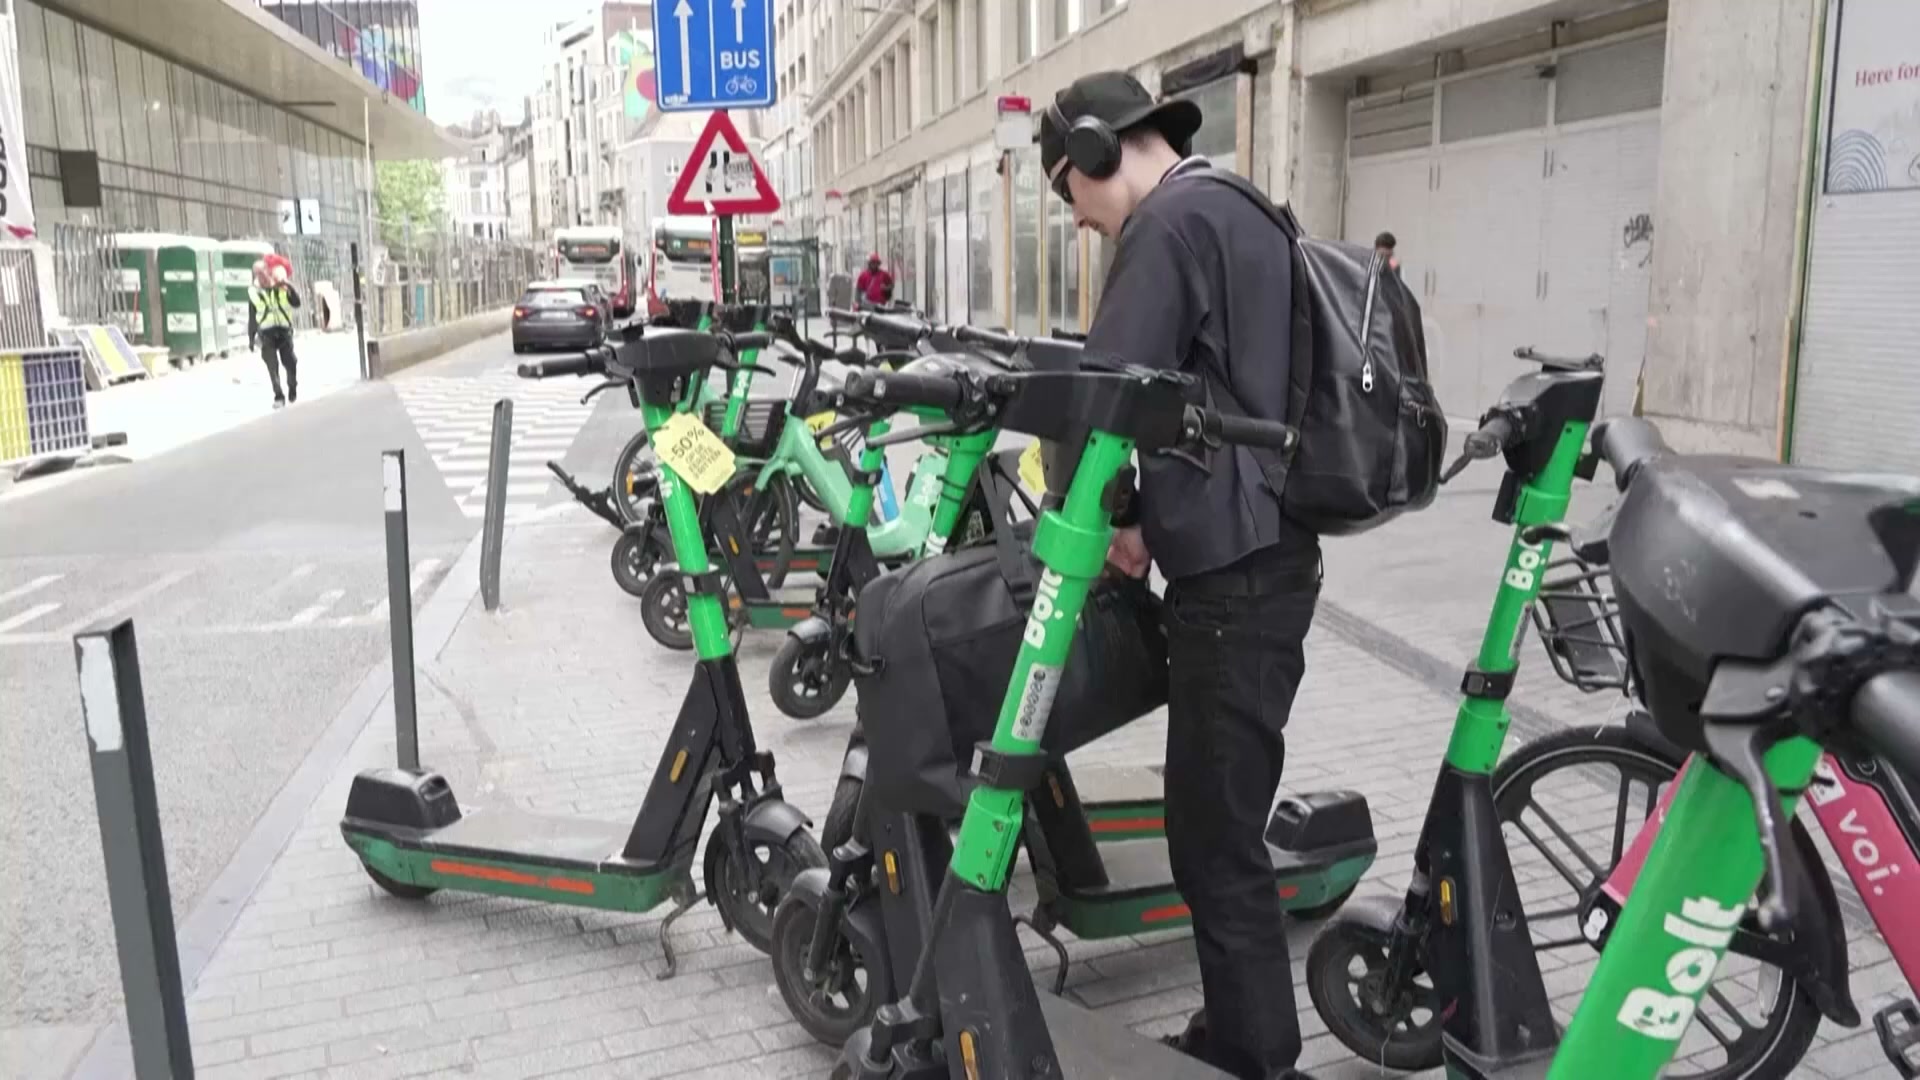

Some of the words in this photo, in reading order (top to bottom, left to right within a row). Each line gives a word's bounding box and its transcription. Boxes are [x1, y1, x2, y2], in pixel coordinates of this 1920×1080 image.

[719, 49, 761, 70] BUS
[1854, 68, 1893, 88] Here
[670, 425, 705, 462] -50%
[1838, 807, 1901, 897] voi.
[1616, 895, 1746, 1041] Bolt
